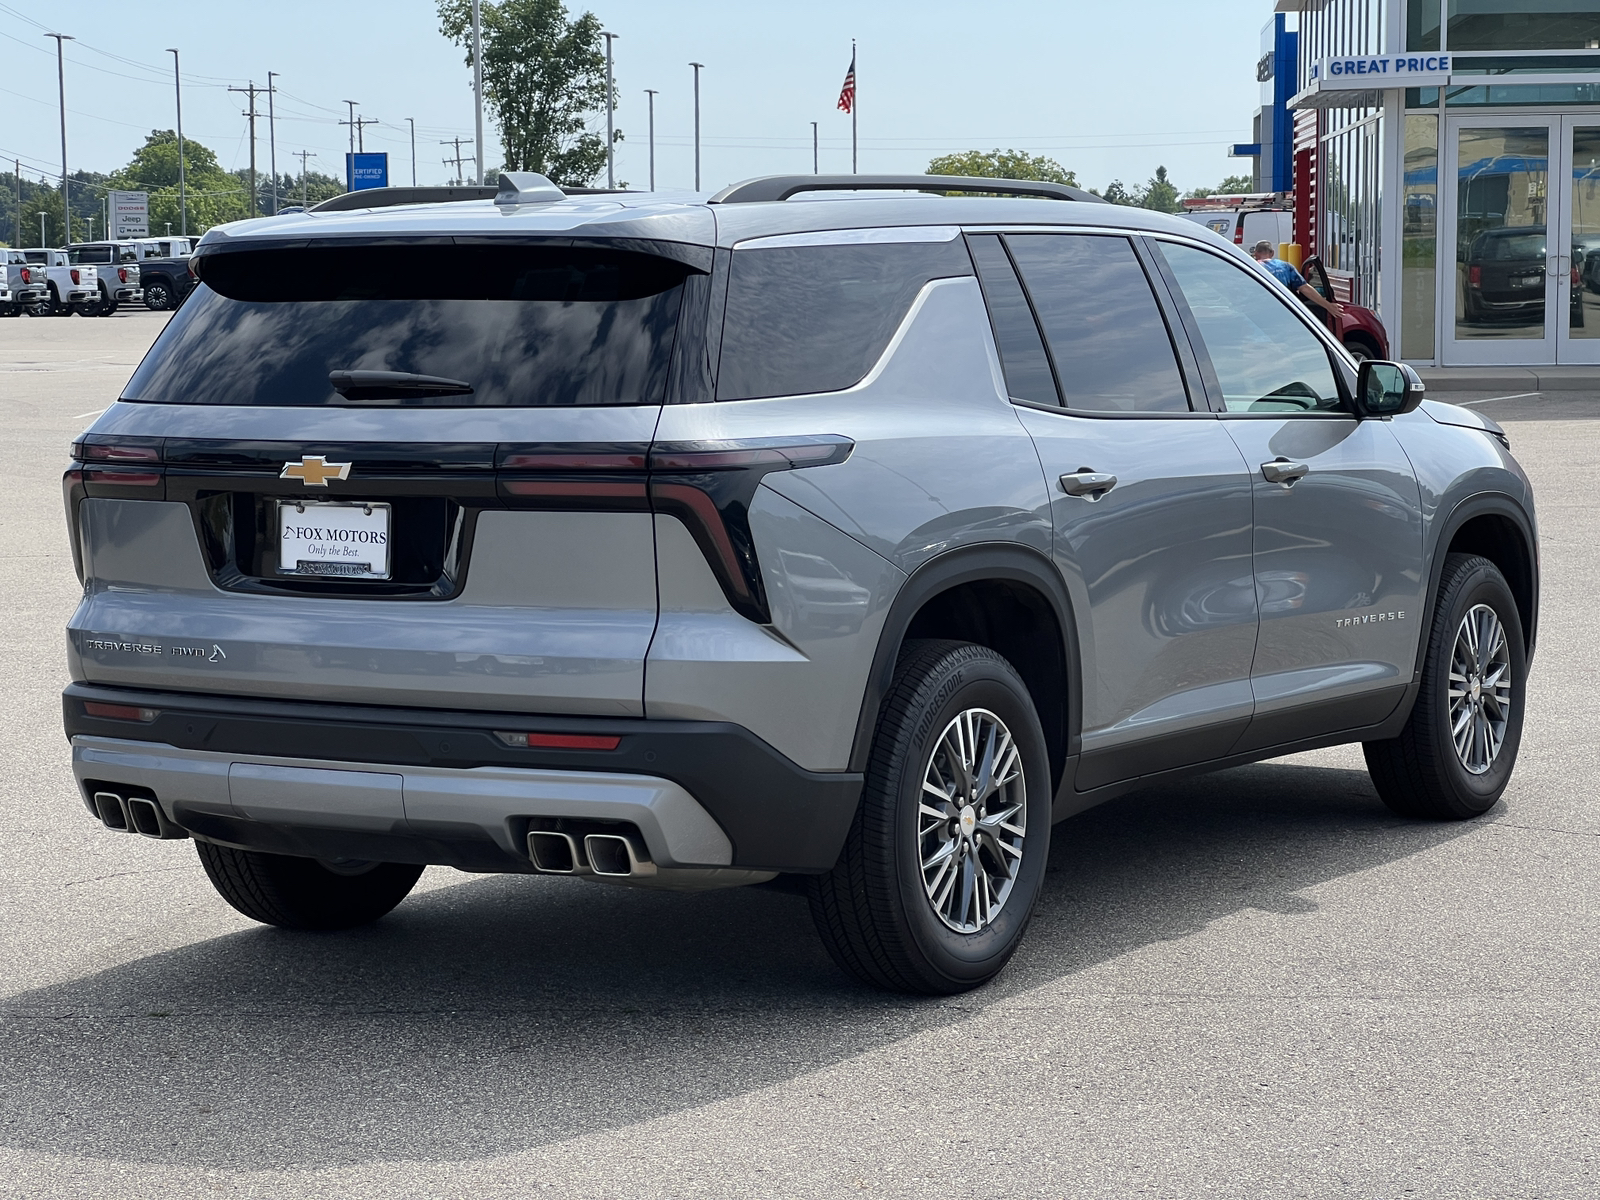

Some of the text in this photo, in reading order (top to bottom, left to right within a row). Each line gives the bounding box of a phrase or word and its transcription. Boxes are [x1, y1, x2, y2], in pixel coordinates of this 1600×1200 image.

[1330, 59, 1390, 76] GREAT
[1395, 56, 1449, 73] PRICE
[122, 215, 141, 223] Jeep
[296, 527, 387, 545] FOX MOTORS
[308, 543, 360, 558] Only the Best.
[1335, 611, 1405, 628] TRAVERSE
[86, 639, 205, 657] TRAVERSE AWD
[914, 669, 965, 750] BRIDGESTONE
